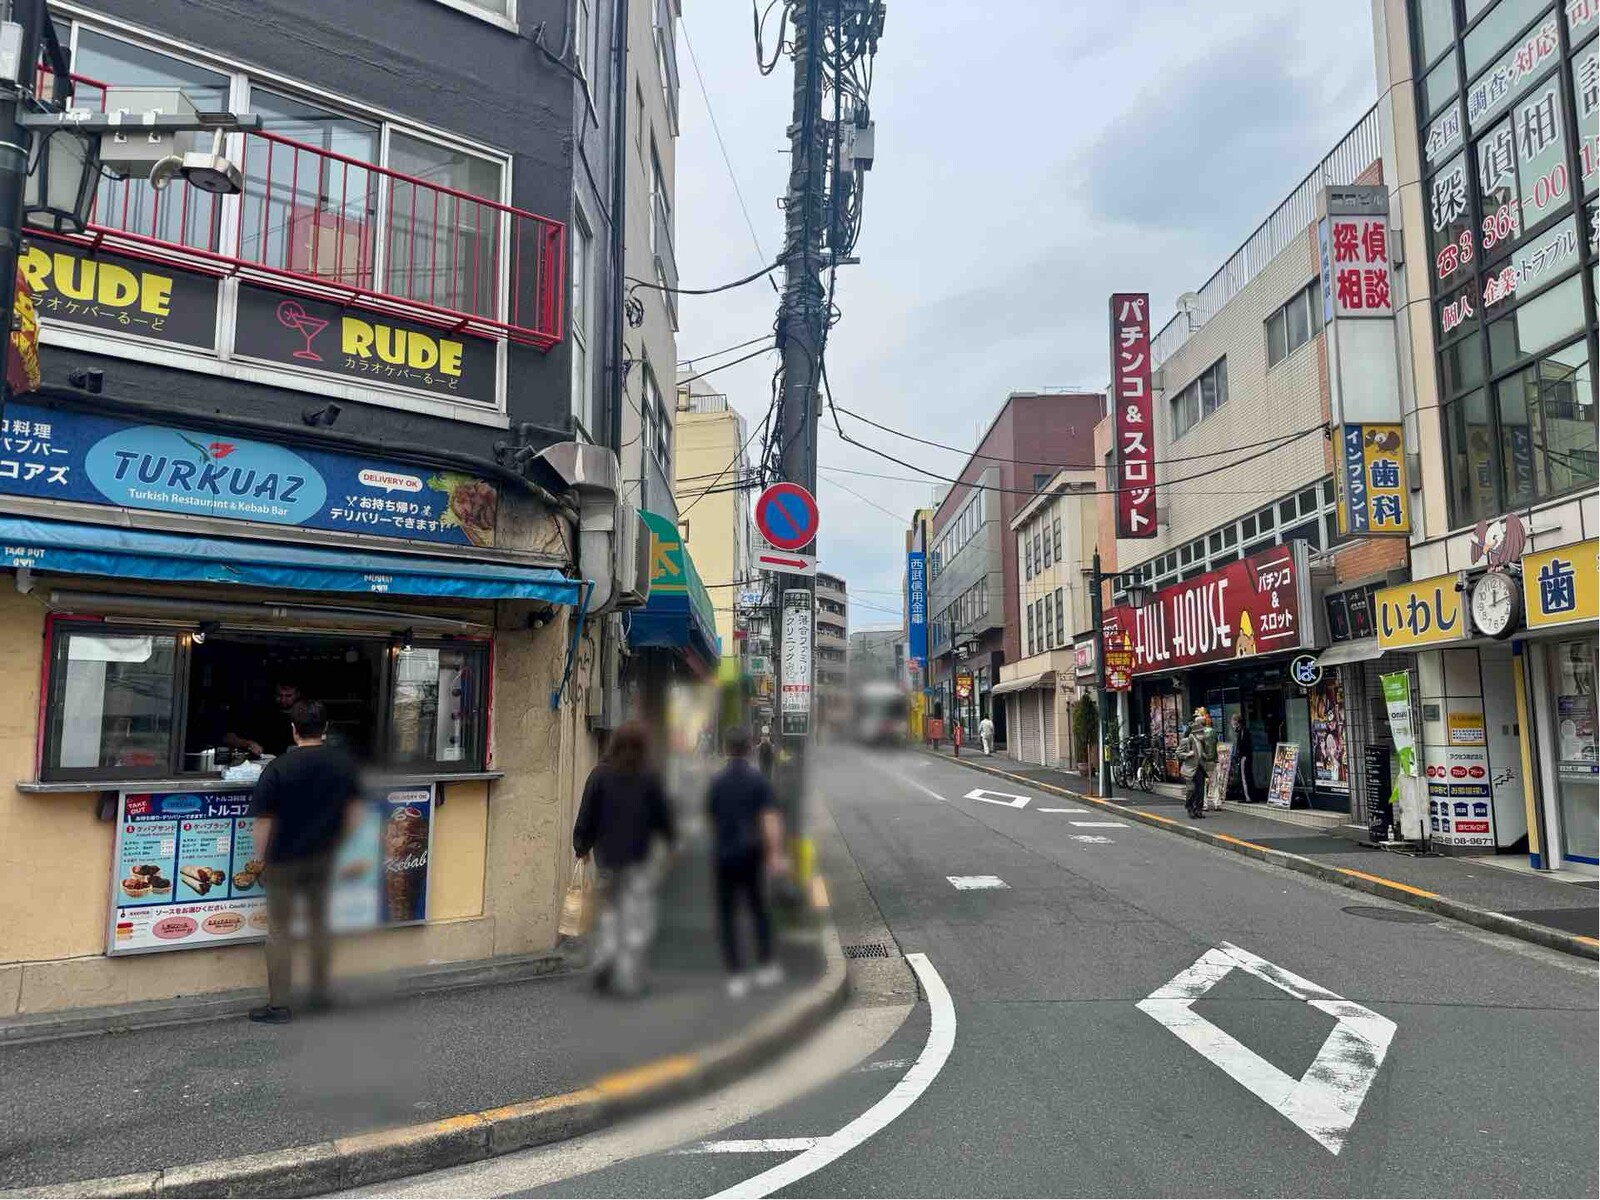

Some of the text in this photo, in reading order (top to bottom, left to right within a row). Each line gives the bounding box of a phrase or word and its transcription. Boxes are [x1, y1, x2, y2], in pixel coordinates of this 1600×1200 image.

[19, 246, 173, 316] RUDE
[342, 316, 463, 377] RUDE
[345, 357, 458, 390] カラオケバーるーど
[0, 460, 71, 486] コアズ
[114, 450, 306, 504] TURKUAZ
[363, 473, 418, 488] DELIVERY OK
[1346, 430, 1365, 528] インプラント
[1370, 458, 1404, 528] 歯科
[128, 488, 289, 517] Turkish Restaurant & Kebab Bar
[360, 496, 419, 515] お持ち帰り
[911, 559, 925, 624] 西武信用金庫
[1258, 567, 1292, 594] パチンコ
[1271, 591, 1280, 608] &
[1538, 558, 1575, 616] 歯
[1136, 577, 1232, 666] FULL HOUSE
[1260, 609, 1294, 632] スロット
[1381, 587, 1457, 638] いわし
[386, 850, 428, 873] Kebab
